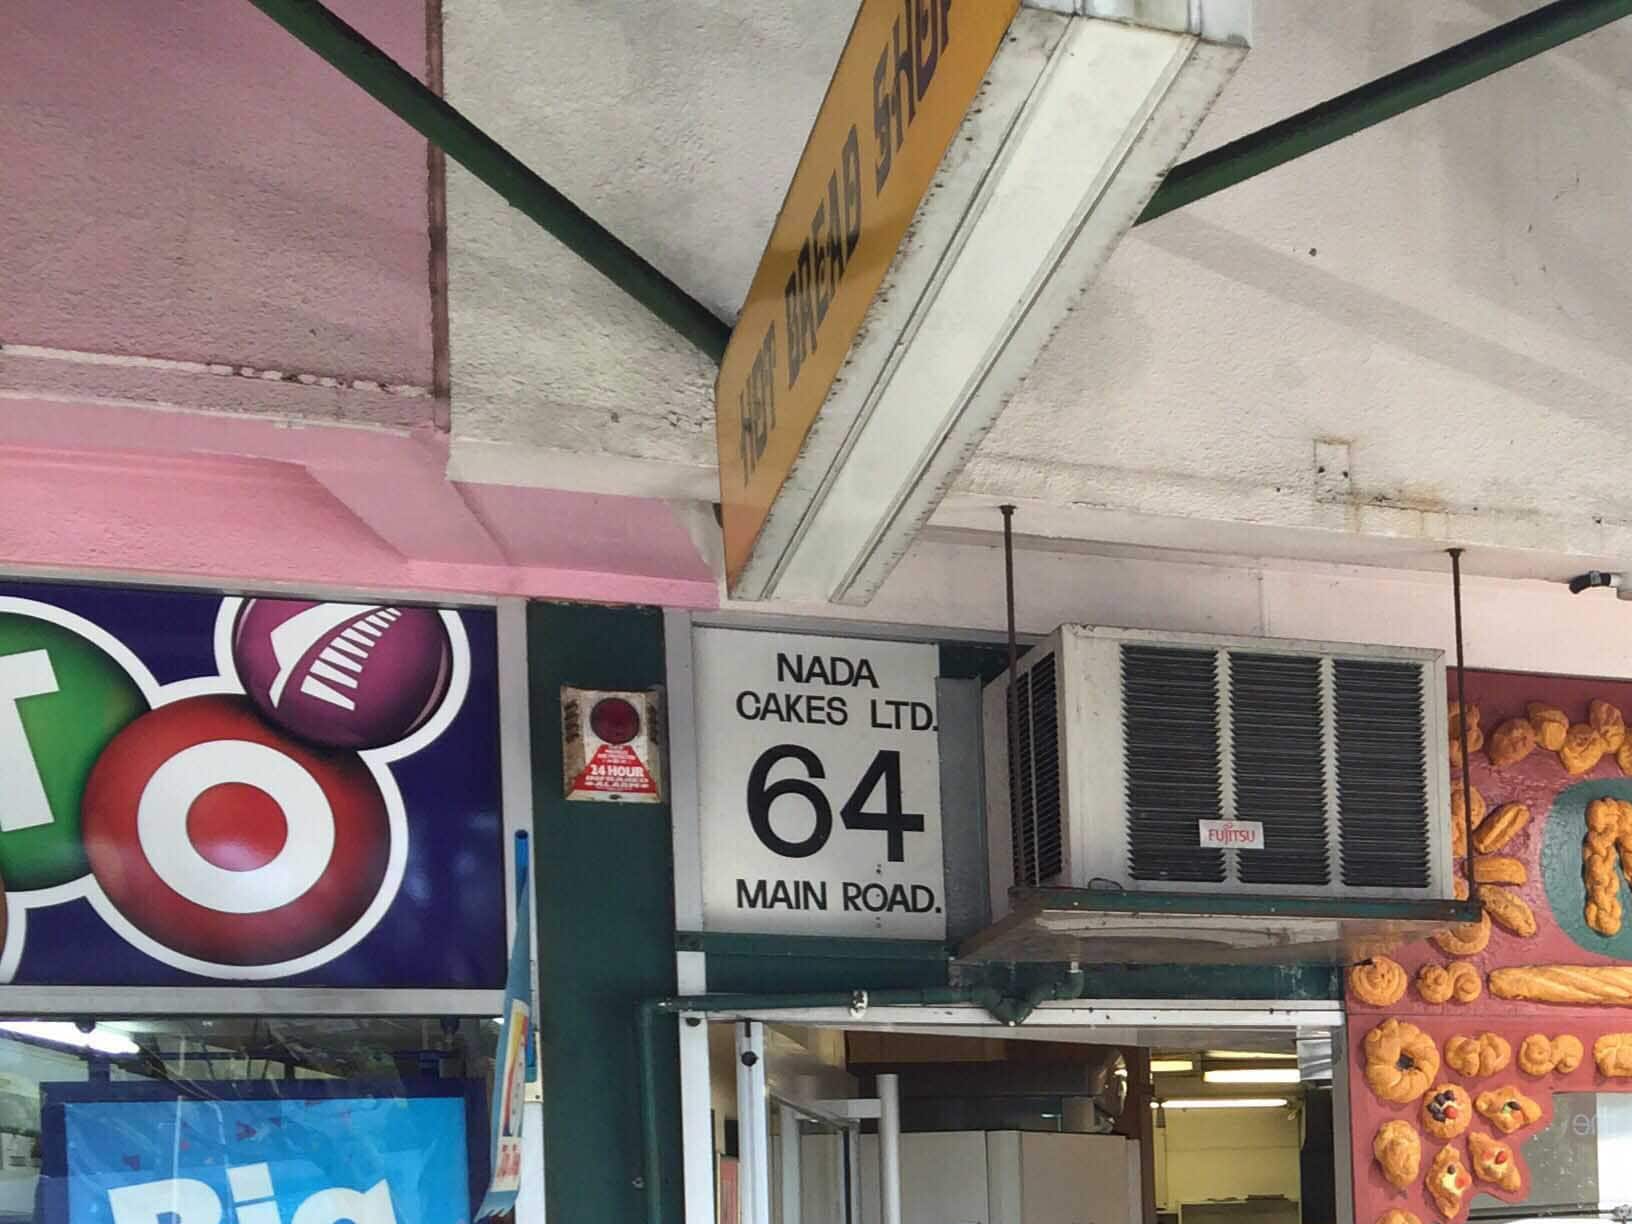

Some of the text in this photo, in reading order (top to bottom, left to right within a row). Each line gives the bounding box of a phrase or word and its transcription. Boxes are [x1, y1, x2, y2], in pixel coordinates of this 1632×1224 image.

[785, 124, 861, 391] BREAD
[873, 0, 952, 197] SHO
[777, 652, 880, 688] NADA
[736, 690, 938, 731] CAKES LTD.
[590, 764, 645, 777] 24 HOUR
[747, 743, 925, 862] 64
[1208, 826, 1255, 845] FUJITSU
[736, 878, 942, 914] MAIN ROAD.
